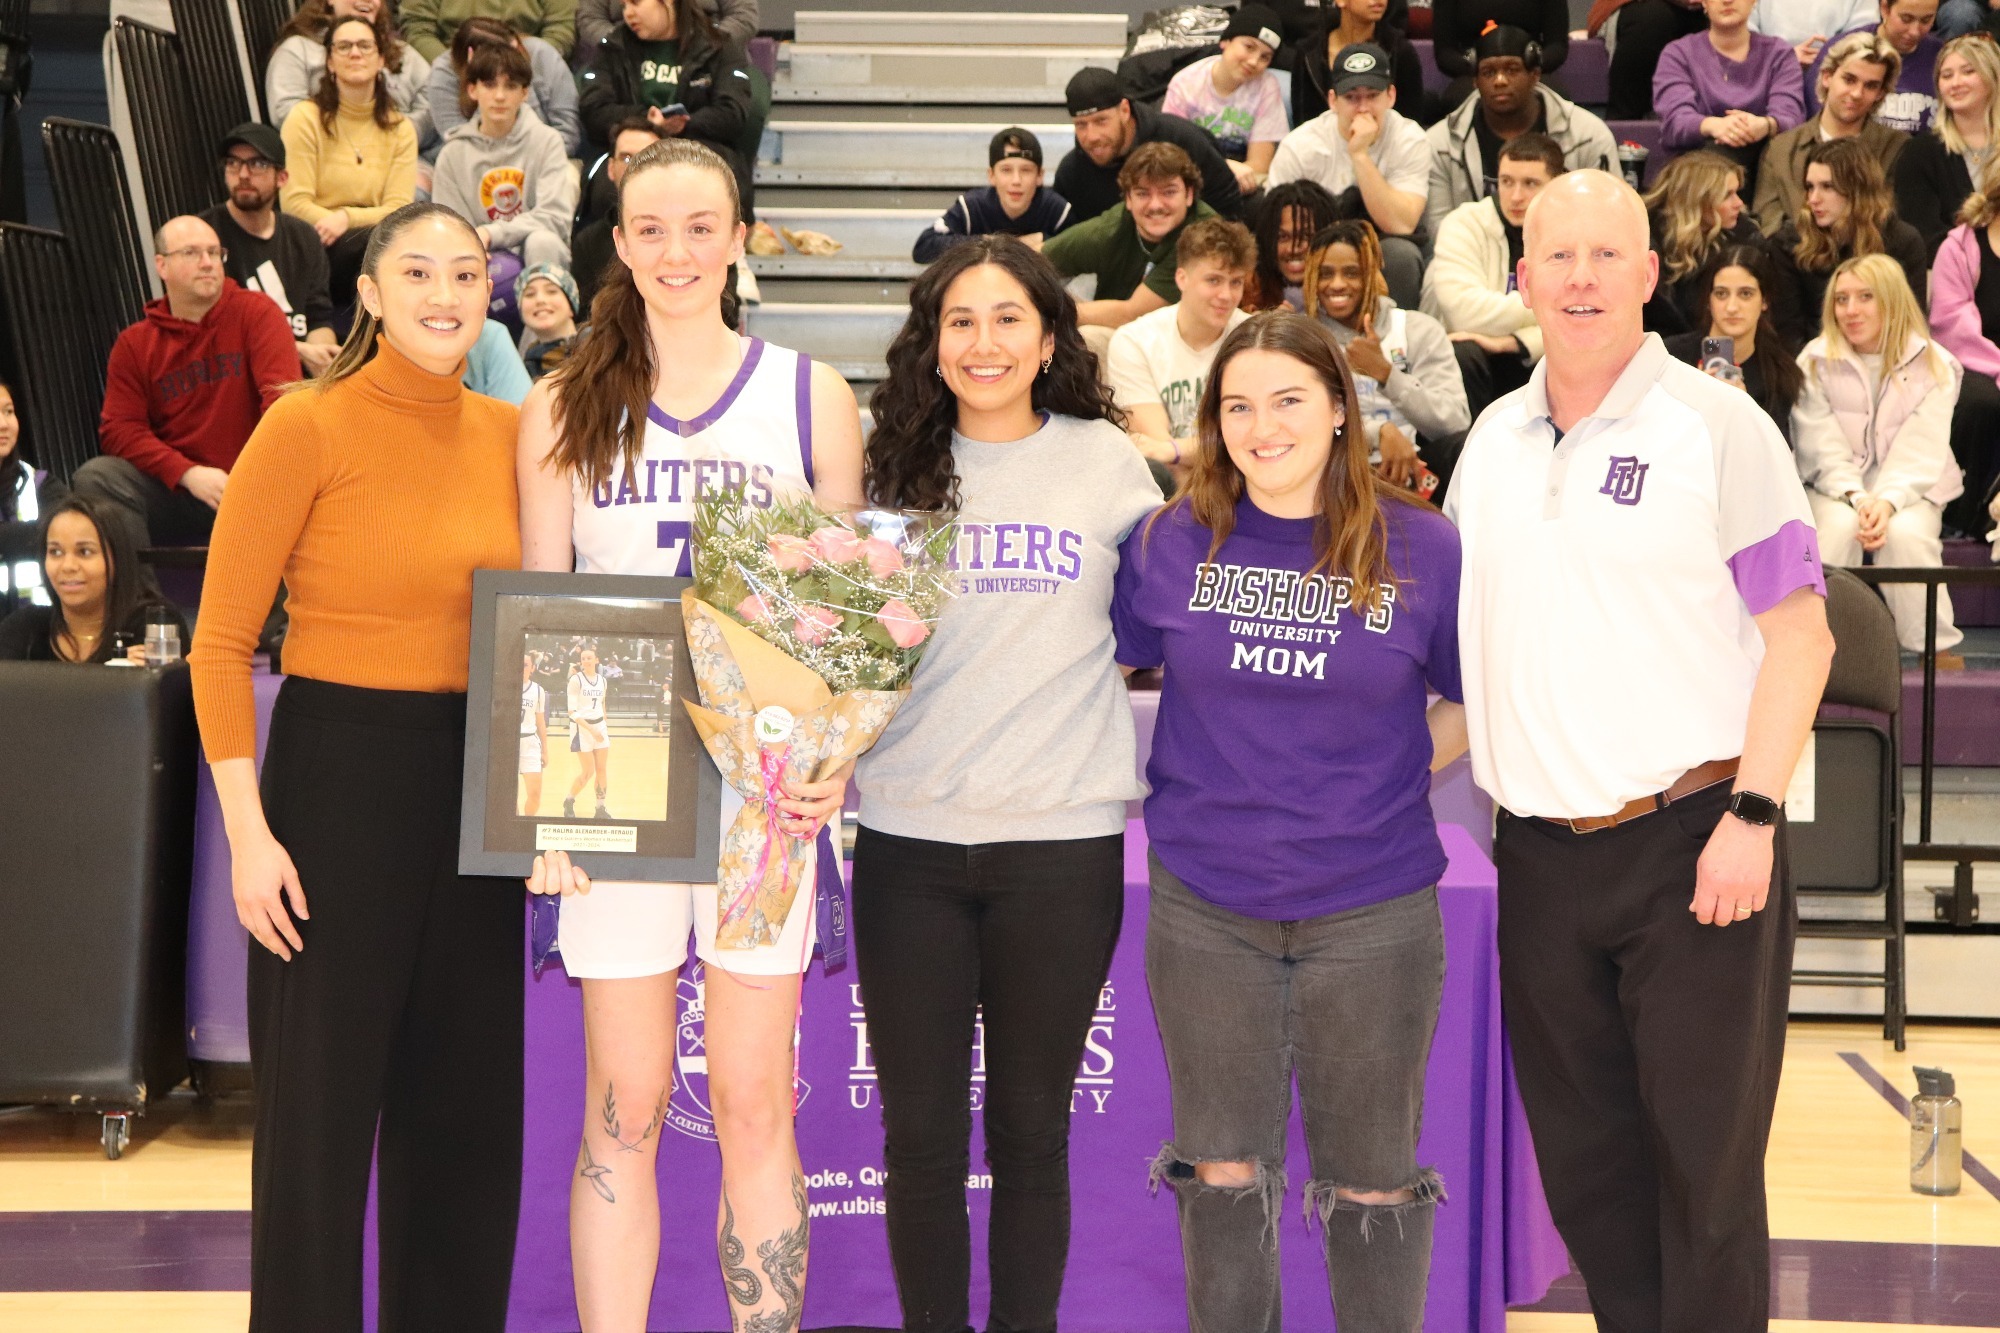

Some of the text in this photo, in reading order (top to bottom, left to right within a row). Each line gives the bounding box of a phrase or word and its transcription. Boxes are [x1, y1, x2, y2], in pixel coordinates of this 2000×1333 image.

[656, 520, 696, 577] 7
[975, 577, 1061, 594] UNIVERSITY
[1188, 562, 1396, 634] BISHOPS
[1229, 619, 1342, 645] UNIVERSITY
[1230, 642, 1328, 680] MOM
